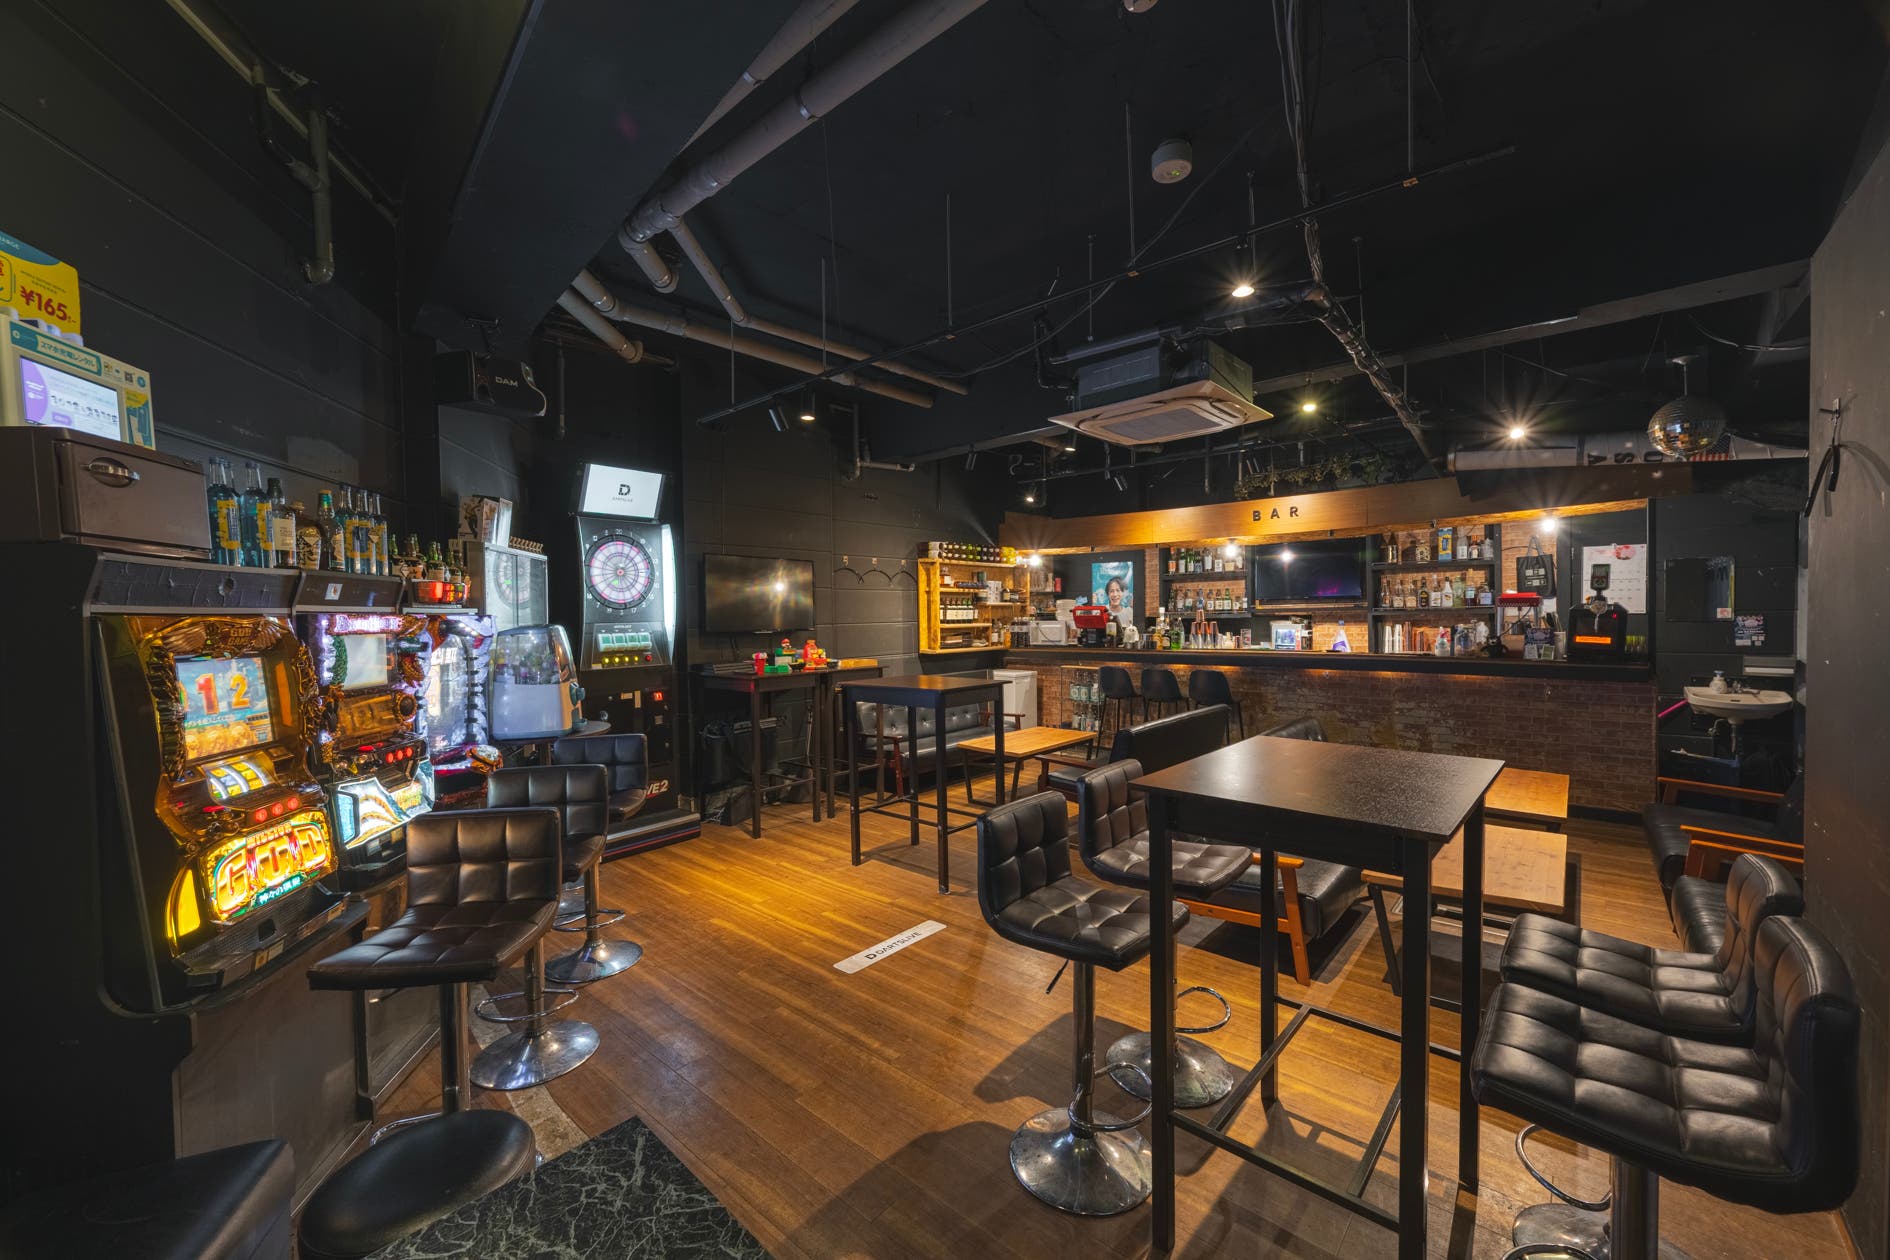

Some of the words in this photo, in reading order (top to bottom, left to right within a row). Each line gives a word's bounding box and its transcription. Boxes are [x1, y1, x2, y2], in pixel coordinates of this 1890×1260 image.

[495, 376, 519, 388] DAM
[1252, 506, 1300, 522] BAR
[196, 673, 220, 715] 1
[230, 673, 250, 709] 2
[216, 824, 327, 912] GOD
[875, 931, 922, 956] DARTSLIVE
